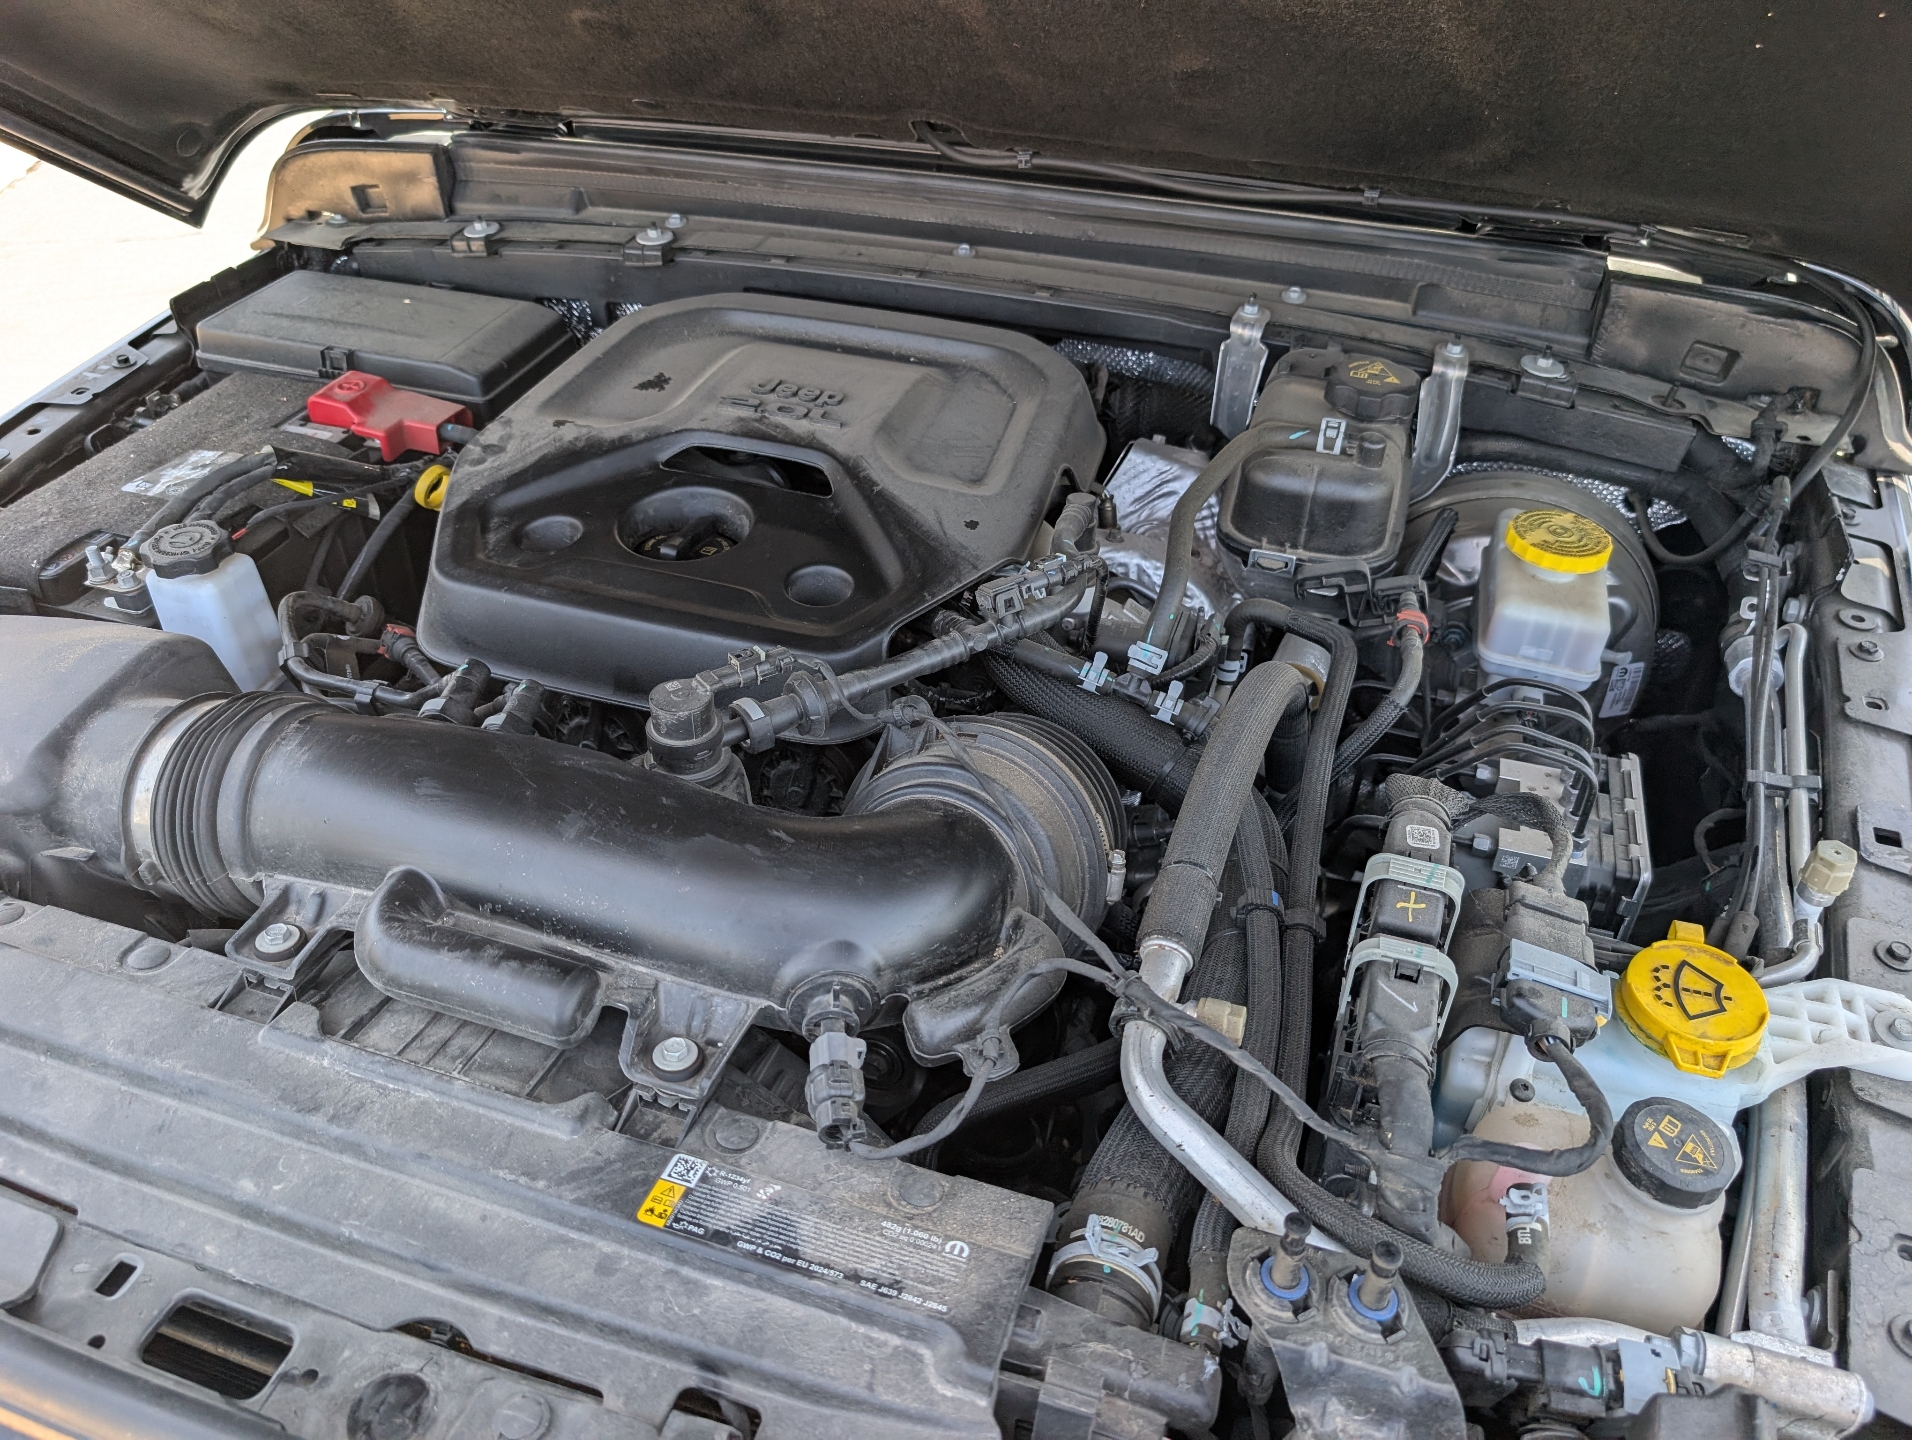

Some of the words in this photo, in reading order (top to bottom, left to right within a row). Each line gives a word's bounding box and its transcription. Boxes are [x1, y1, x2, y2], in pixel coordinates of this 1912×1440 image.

[750, 379, 844, 408] Jeep
[719, 396, 843, 429] 2.0L
[715, 1178, 733, 1187] GWP
[732, 1183, 751, 1193] 0.501
[719, 1170, 752, 1184] R-1234yf
[687, 1224, 706, 1236] PAG
[736, 1240, 757, 1252] GWP
[756, 1247, 764, 1255] &
[764, 1249, 783, 1261] CO2
[781, 1255, 797, 1265] per
[796, 1259, 810, 1269] EU
[808, 1263, 845, 1280] 2024/573
[860, 1279, 878, 1291] SAE
[877, 1286, 899, 1297] J639
[898, 1292, 924, 1305] J2842
